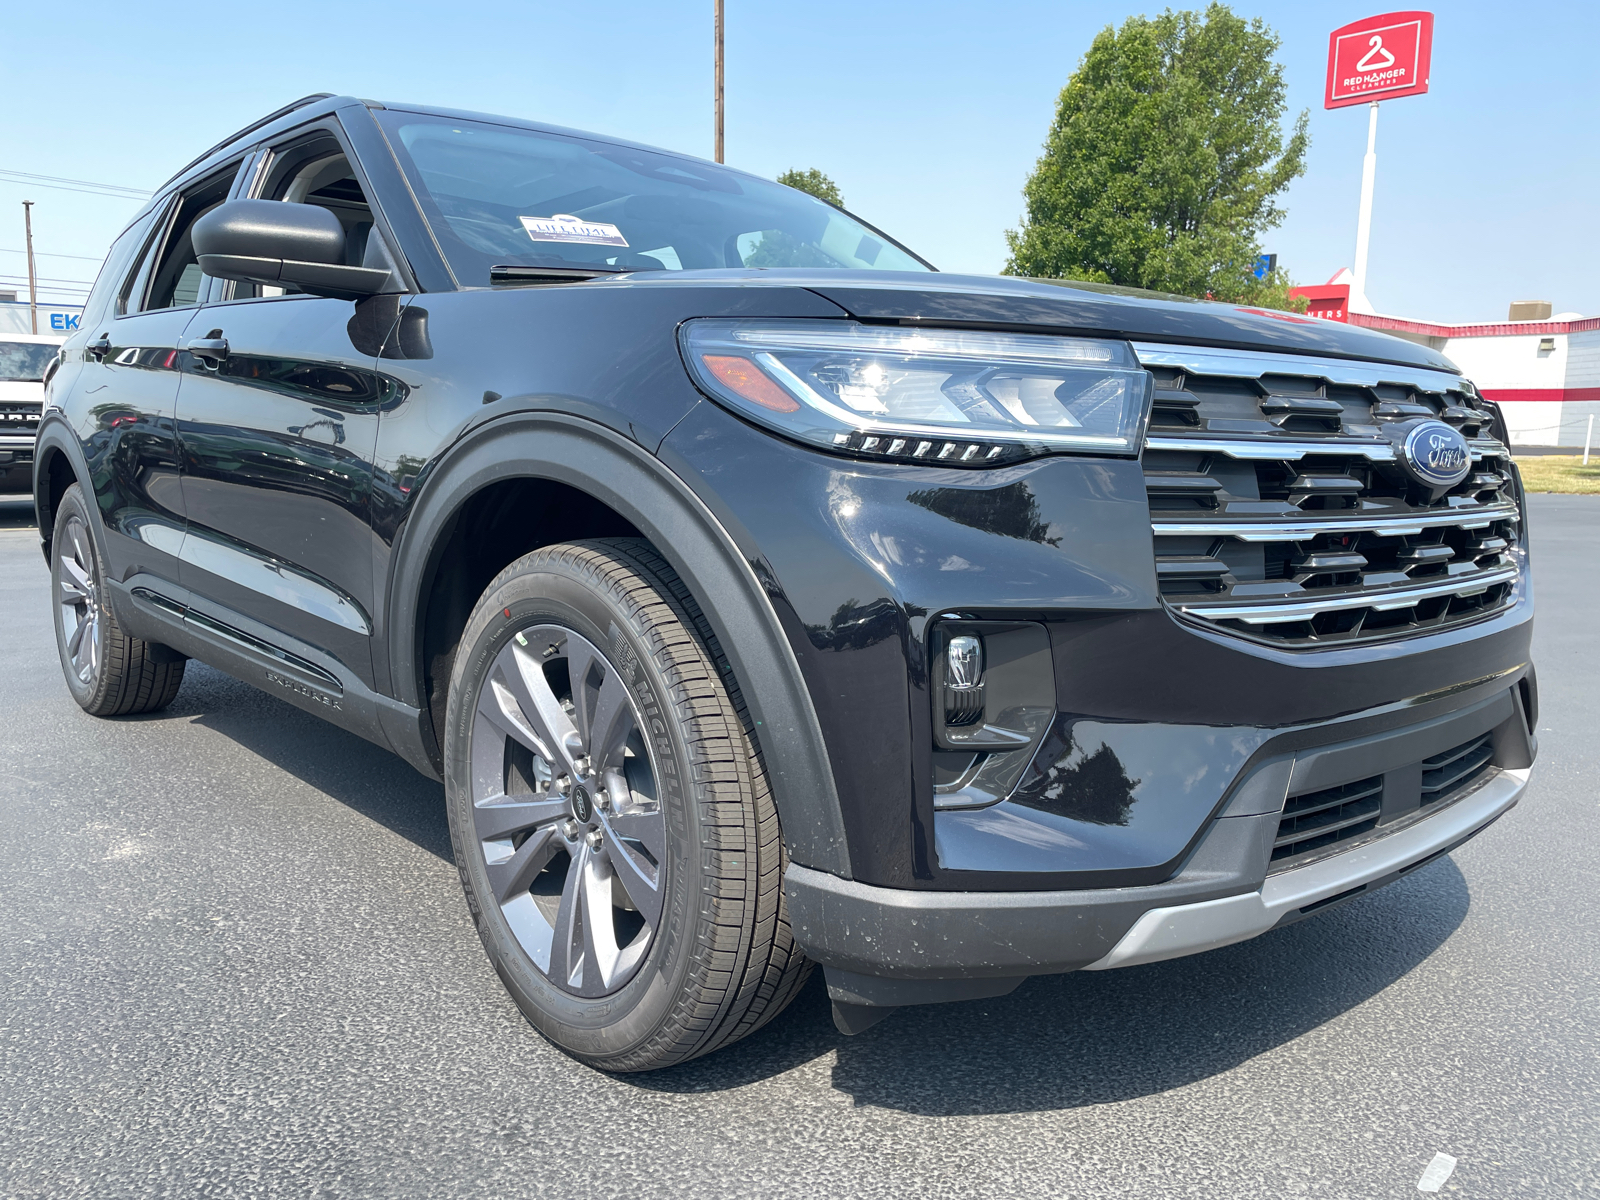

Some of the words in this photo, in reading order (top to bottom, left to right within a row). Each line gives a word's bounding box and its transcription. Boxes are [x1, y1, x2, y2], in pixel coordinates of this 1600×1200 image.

[1344, 76, 1362, 86] RED
[1364, 69, 1405, 82] HANGER
[1352, 79, 1396, 90] CLEANERS
[1428, 434, 1464, 468] Ford
[265, 671, 343, 711] EXPLORER
[636, 680, 684, 832] MICHELIN
[670, 856, 688, 943] PRIMACY
